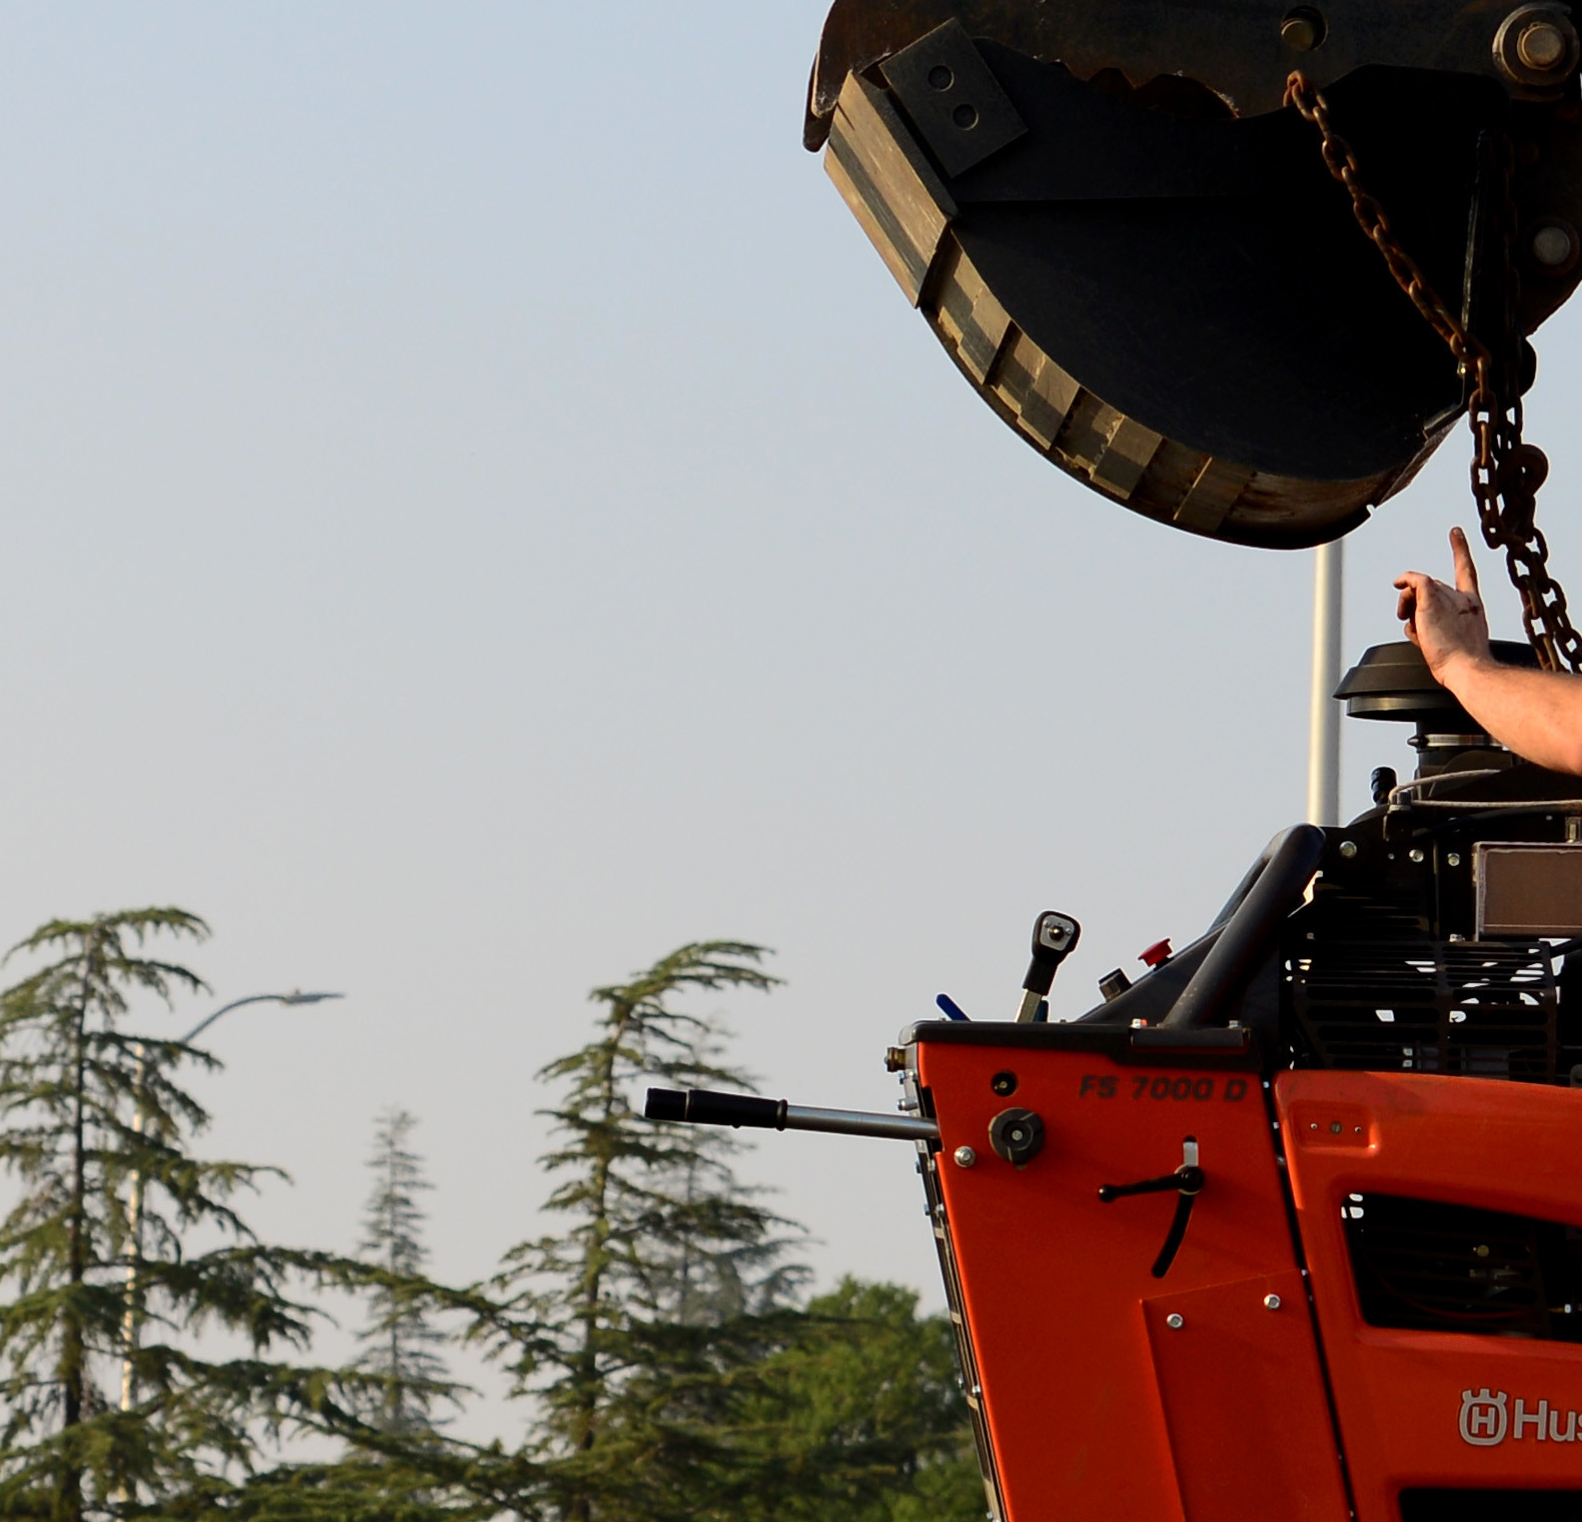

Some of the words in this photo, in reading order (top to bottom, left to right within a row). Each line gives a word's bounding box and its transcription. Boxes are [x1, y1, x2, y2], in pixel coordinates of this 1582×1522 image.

[1078, 1073, 1119, 1098] FS
[1131, 1075, 1214, 1101] 7000
[1224, 1078, 1248, 1101] D
